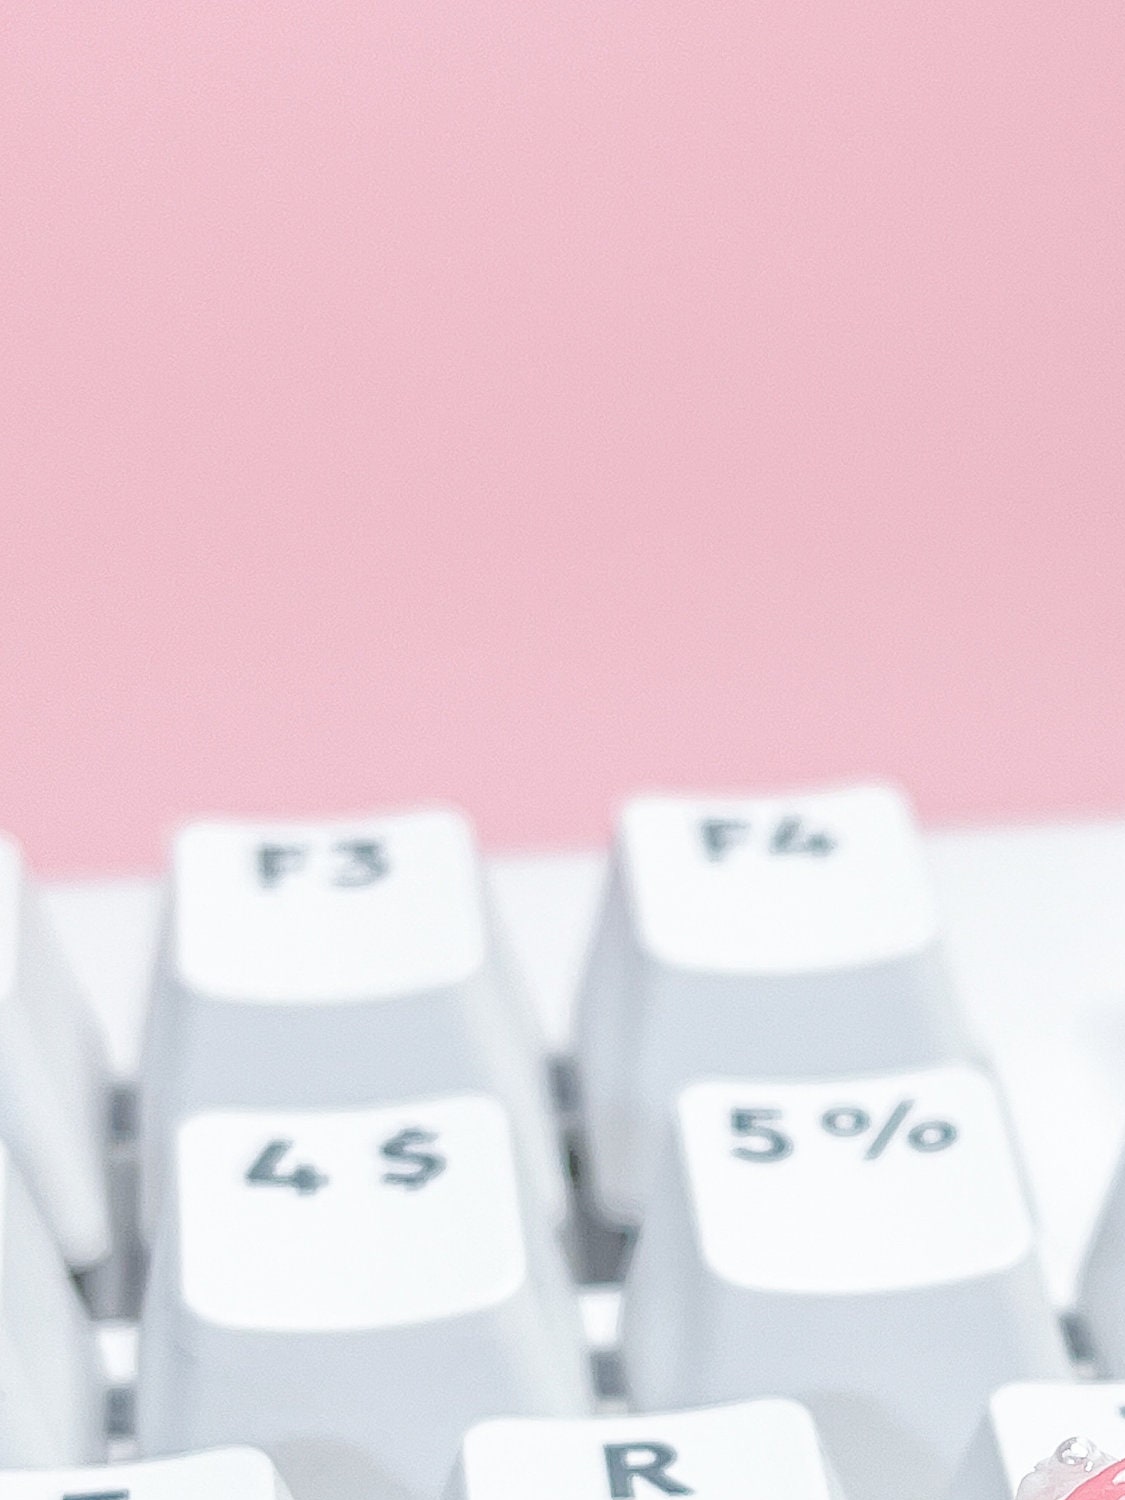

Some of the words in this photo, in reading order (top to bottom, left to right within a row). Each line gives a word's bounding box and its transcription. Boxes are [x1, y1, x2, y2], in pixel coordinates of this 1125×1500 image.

[256, 839, 389, 888] F3
[700, 817, 836, 862] F4
[245, 1140, 327, 1195] 4
[379, 1128, 445, 1190] $
[603, 1442, 693, 1500] R
